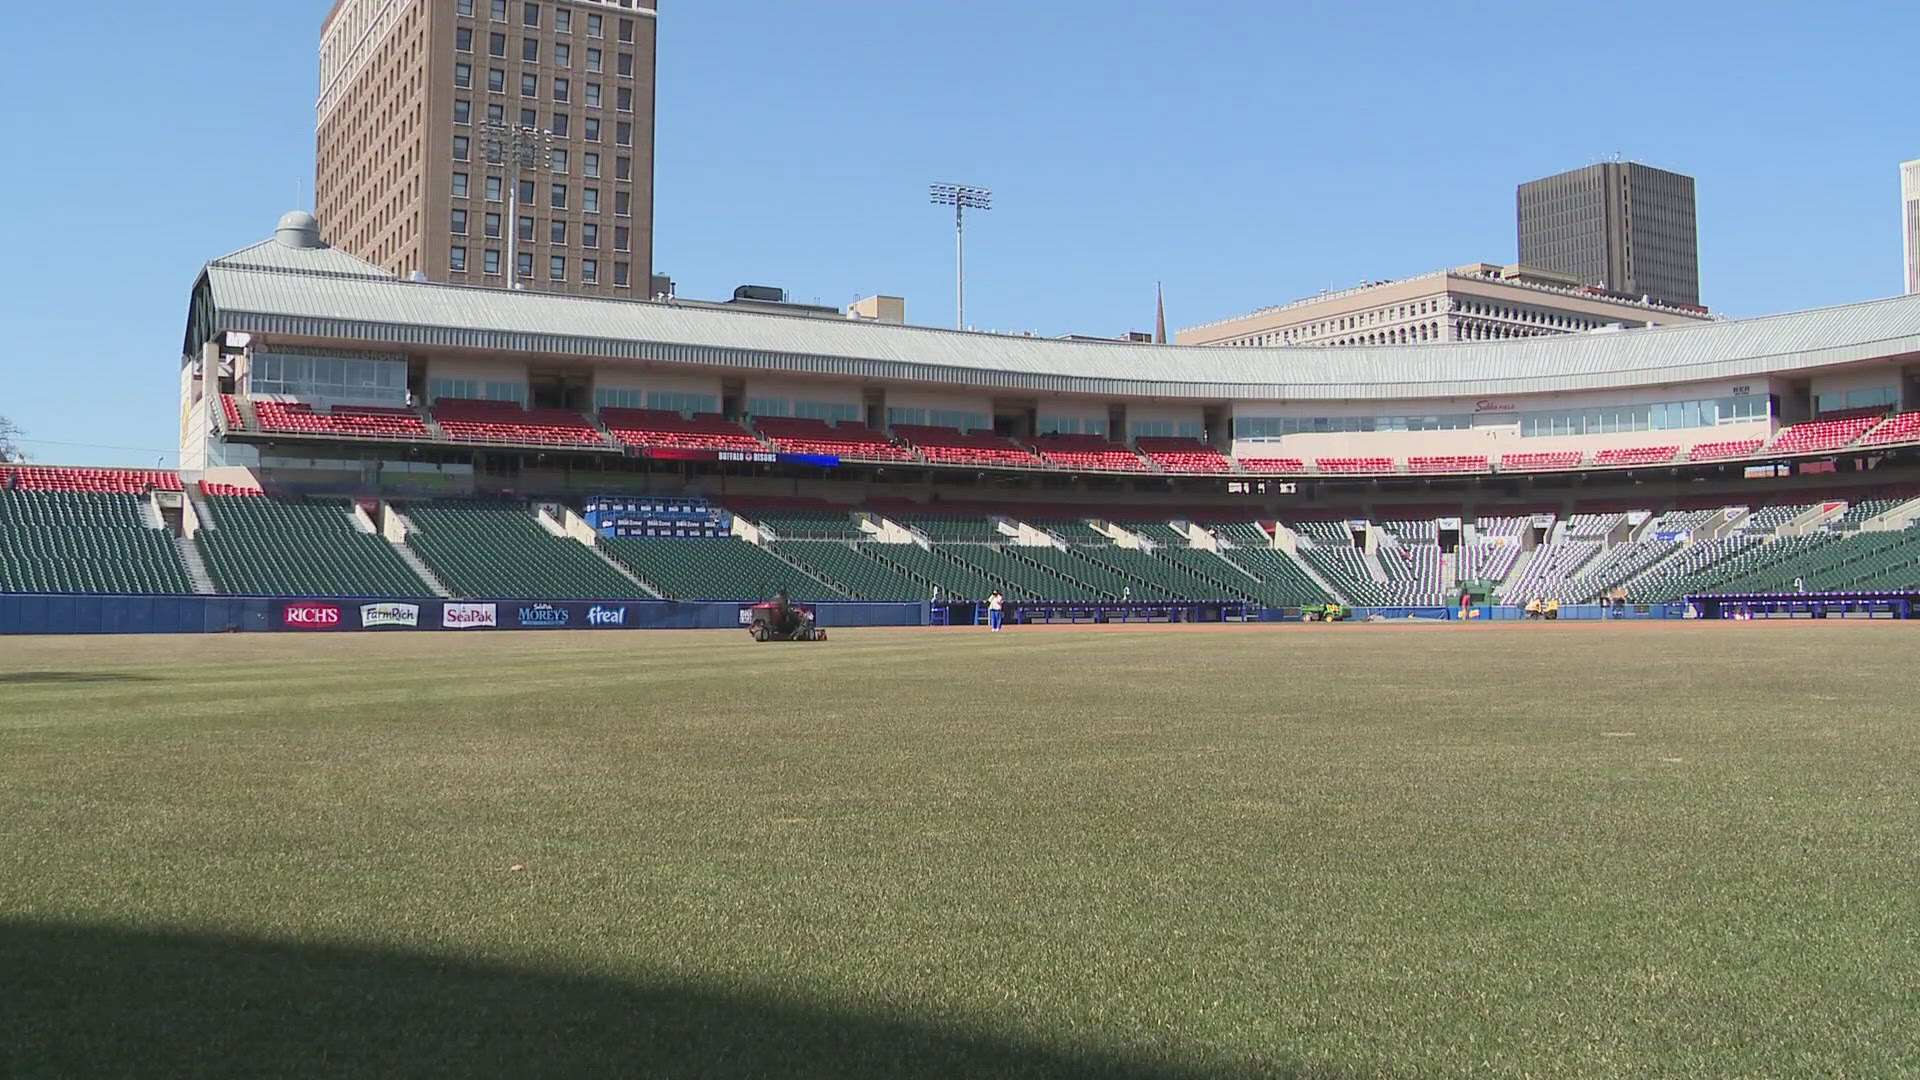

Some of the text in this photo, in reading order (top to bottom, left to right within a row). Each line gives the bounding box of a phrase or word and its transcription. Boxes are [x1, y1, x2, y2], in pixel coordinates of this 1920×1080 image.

[718, 452, 777, 462] BUFFALO BISONS
[447, 608, 493, 623] SeaPak
[518, 607, 569, 621] MOREY'S
